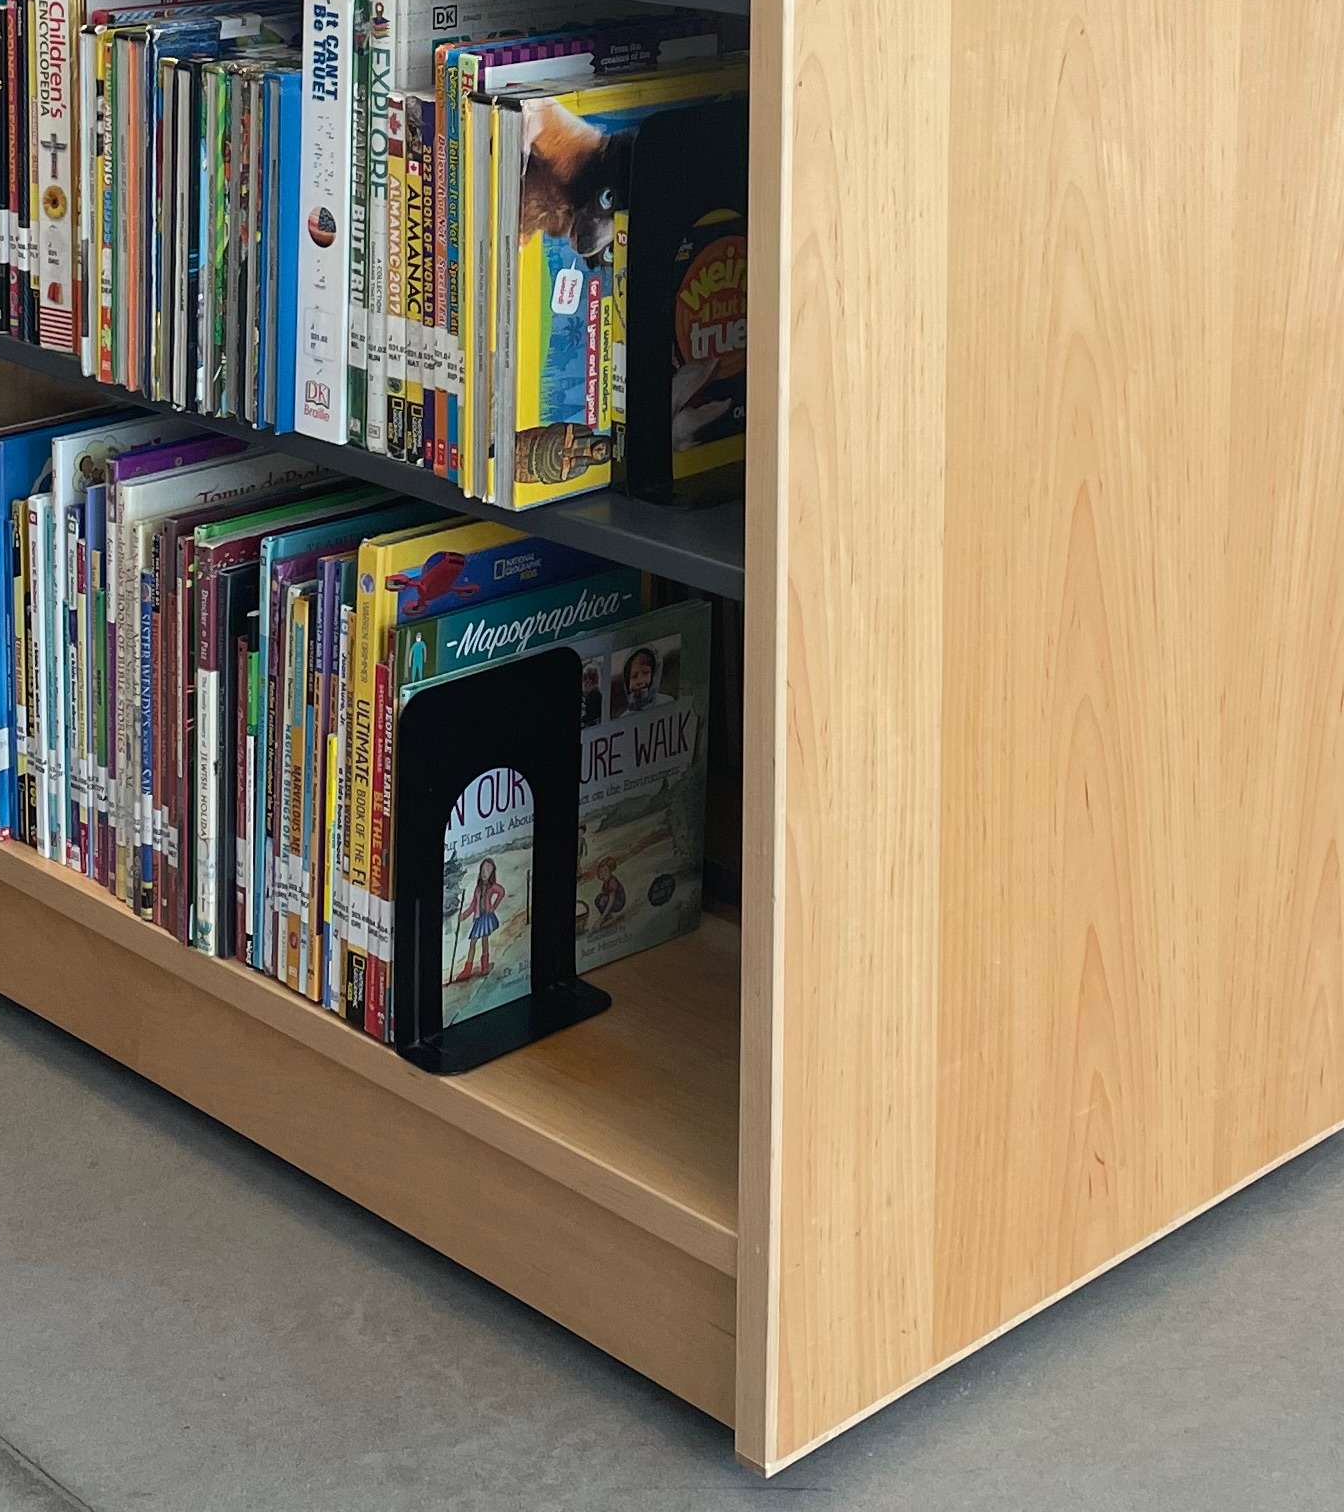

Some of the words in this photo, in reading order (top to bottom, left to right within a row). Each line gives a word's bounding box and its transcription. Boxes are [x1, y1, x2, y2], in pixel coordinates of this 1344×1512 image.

[313, 4, 326, 31] Be
[436, 10, 454, 25] DK
[39, 0, 50, 116] ENCYCLOPEDIA
[49, 1, 66, 119] Children's
[312, 40, 326, 101] TRUE!
[325, 36, 338, 100] CAN'T
[423, 145, 431, 181] 2022
[388, 174, 401, 266] ALMANAC
[423, 187, 433, 228] BOOK
[407, 184, 422, 320] ALMANAC
[387, 268, 400, 316] 2017
[423, 251, 433, 308] WORLD
[589, 280, 600, 296] for
[680, 246, 746, 311] weir
[589, 300, 599, 321] this
[587, 324, 597, 351] year
[589, 355, 597, 376] and
[141, 613, 151, 665] SISTER
[141, 667, 151, 727] WENDY'S
[354, 698, 370, 787] ULTIMATE
[581, 731, 625, 785] URE
[634, 710, 692, 768] WALK
[354, 789, 366, 822] BOOK
[477, 768, 526, 819] OUR
[354, 843, 365, 867] THE
[461, 831, 482, 847] First
[485, 821, 505, 838] Talk
